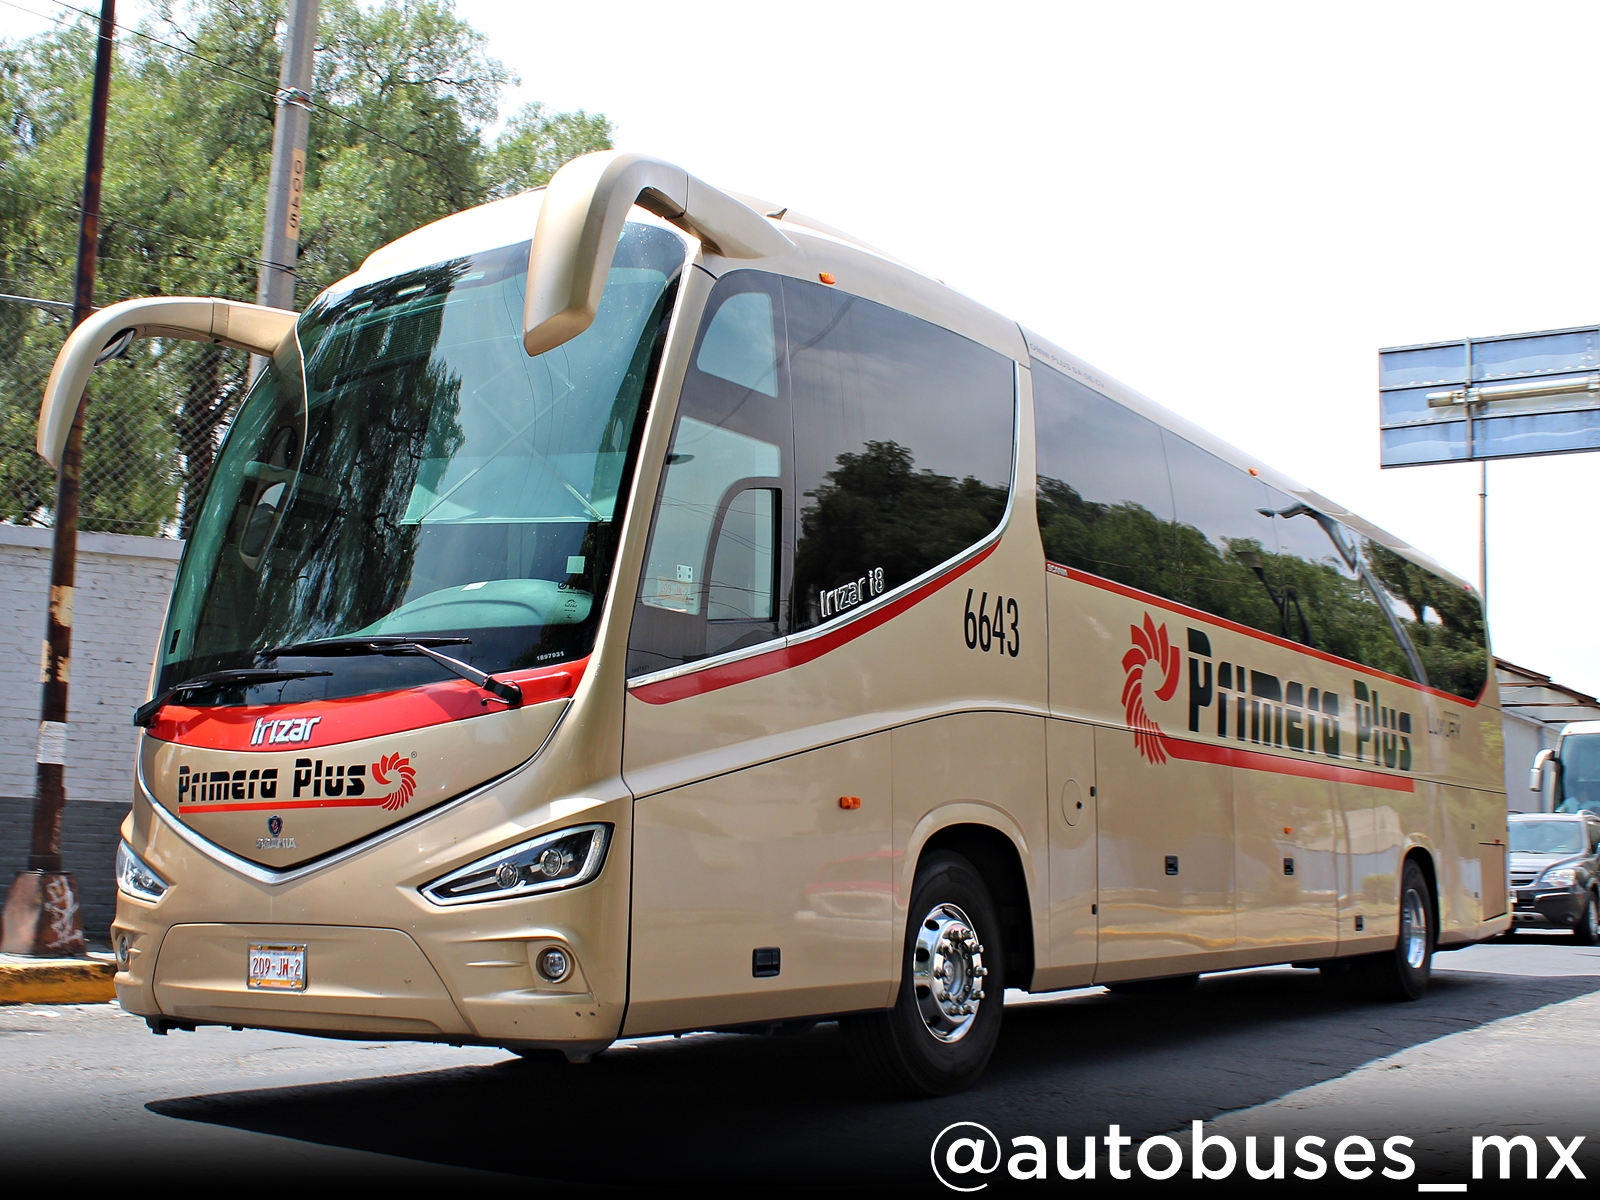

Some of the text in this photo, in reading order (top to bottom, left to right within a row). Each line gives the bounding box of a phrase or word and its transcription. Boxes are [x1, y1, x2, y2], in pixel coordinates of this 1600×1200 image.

[868, 567, 886, 597] i8
[964, 588, 1020, 657] 6643
[1186, 626, 1412, 772] Primera Plus
[250, 716, 321, 745] Irizar
[178, 757, 367, 802] Primera Plus
[256, 838, 297, 849] SCANIA
